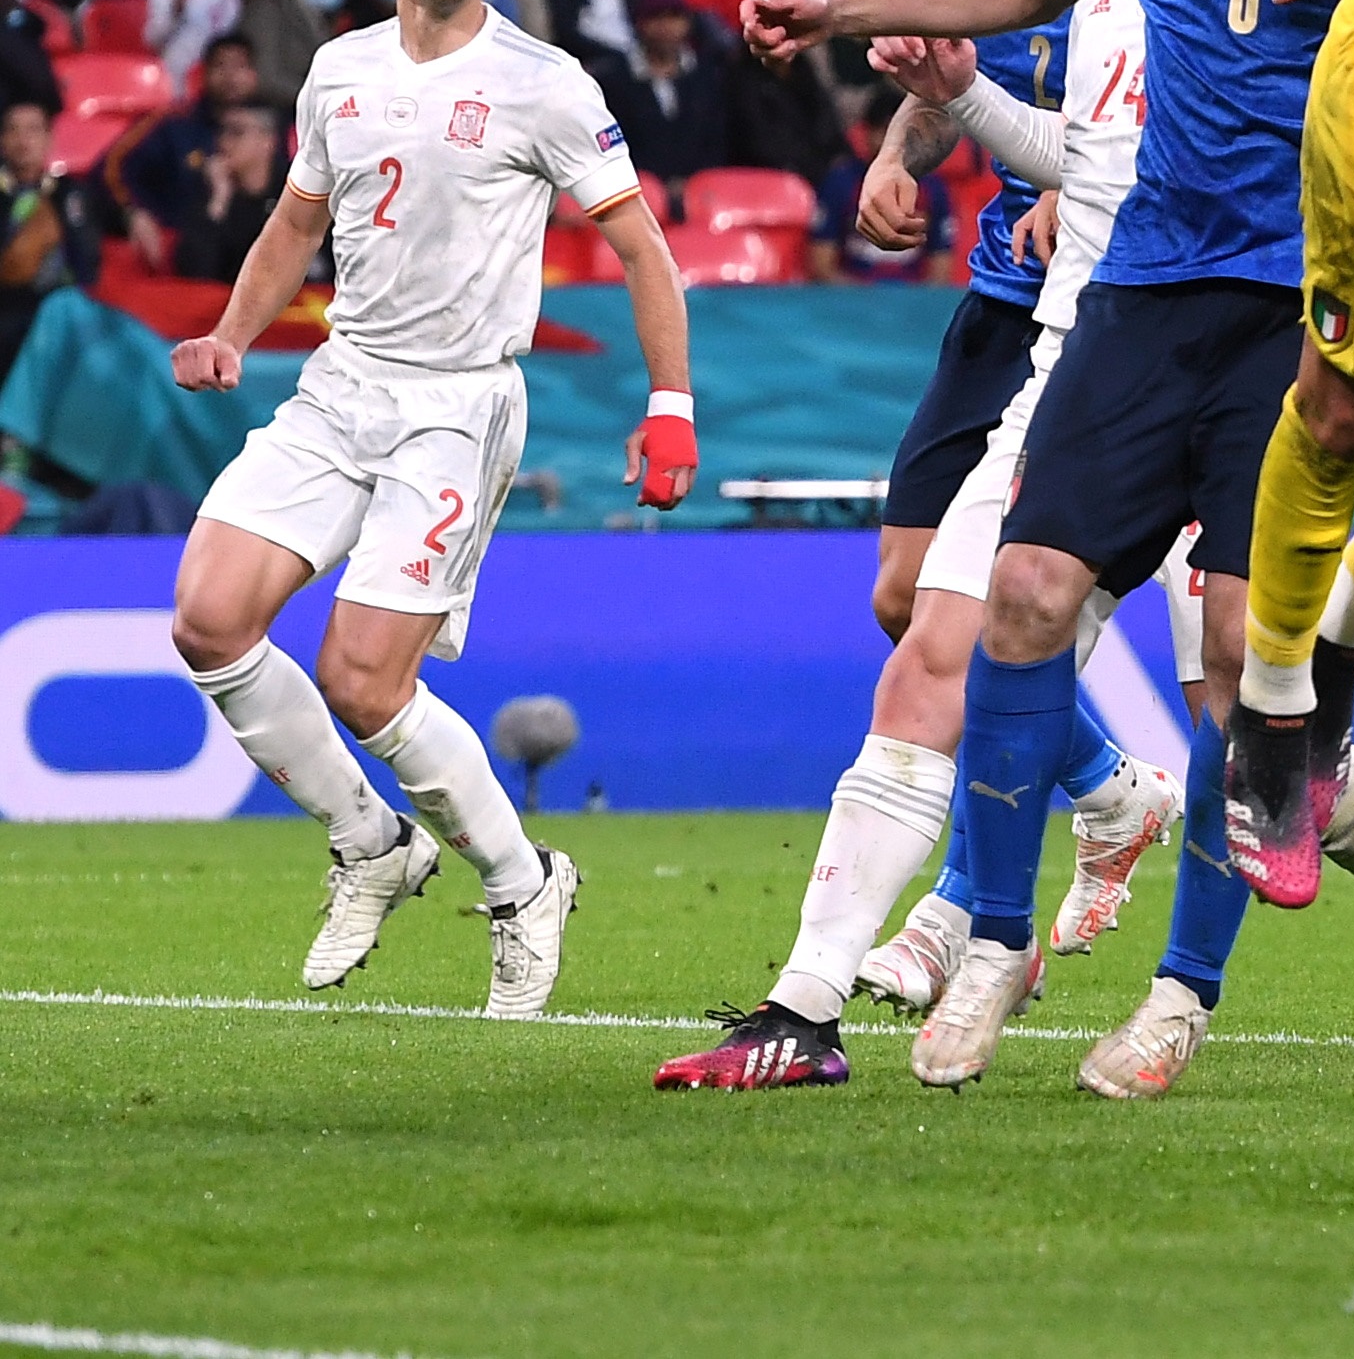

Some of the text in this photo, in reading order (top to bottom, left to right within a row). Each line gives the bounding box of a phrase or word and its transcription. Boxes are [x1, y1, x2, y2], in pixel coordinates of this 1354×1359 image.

[1028, 34, 1059, 109] 2
[1090, 49, 1147, 126] 24
[373, 157, 402, 229] 2
[423, 488, 464, 555] 2
